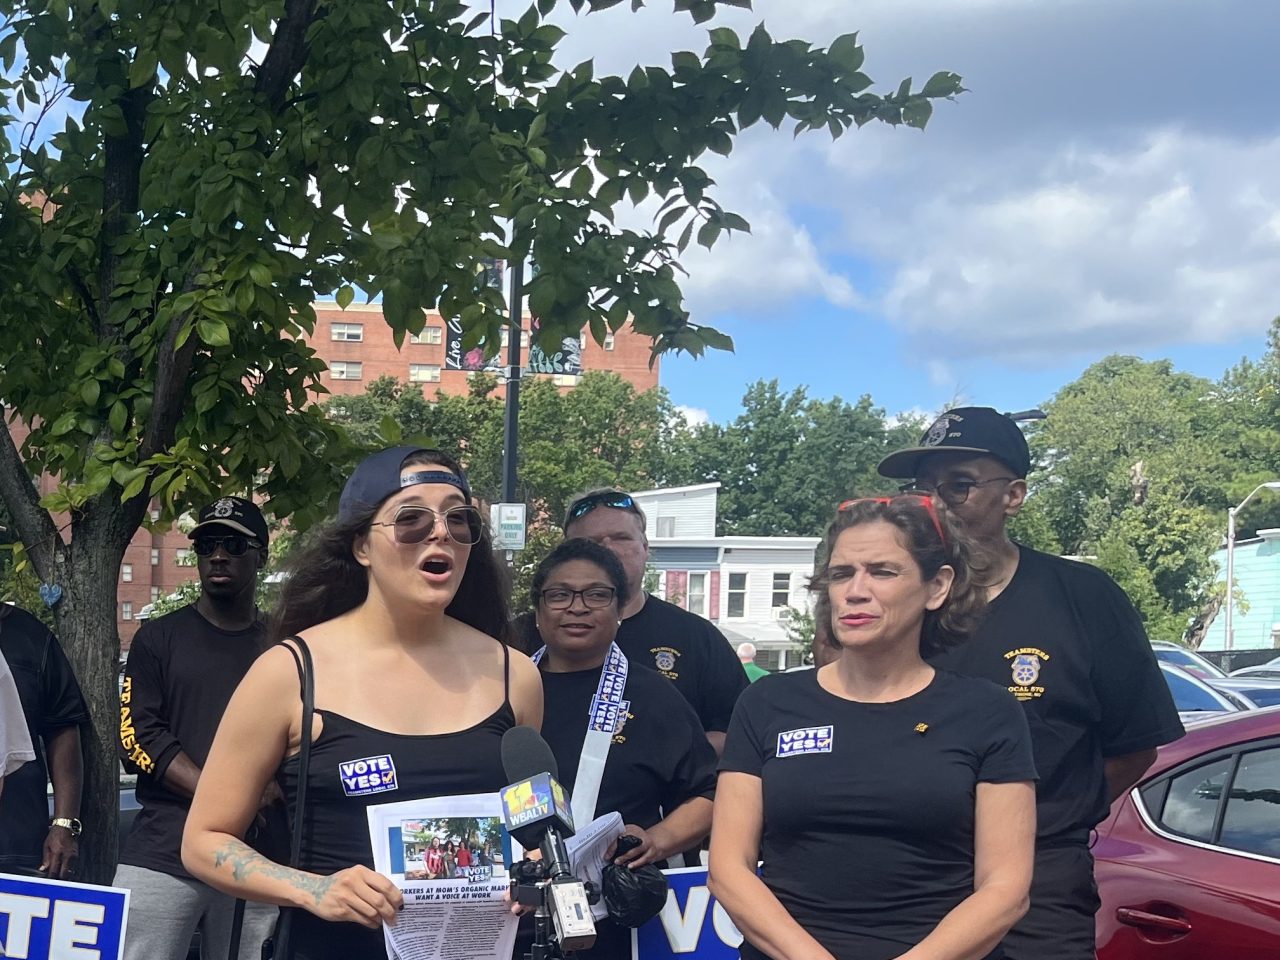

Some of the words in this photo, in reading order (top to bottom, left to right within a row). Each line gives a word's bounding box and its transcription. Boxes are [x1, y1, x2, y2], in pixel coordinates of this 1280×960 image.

[602, 674, 616, 694] YES
[611, 676, 625, 703] VOTE
[595, 703, 609, 725] YES
[603, 705, 617, 732] VOTE
[781, 729, 829, 743] VOTE
[781, 739, 816, 752] YES
[342, 757, 390, 777] VOTE
[344, 773, 381, 790] YES
[468, 867, 491, 875] VOTE
